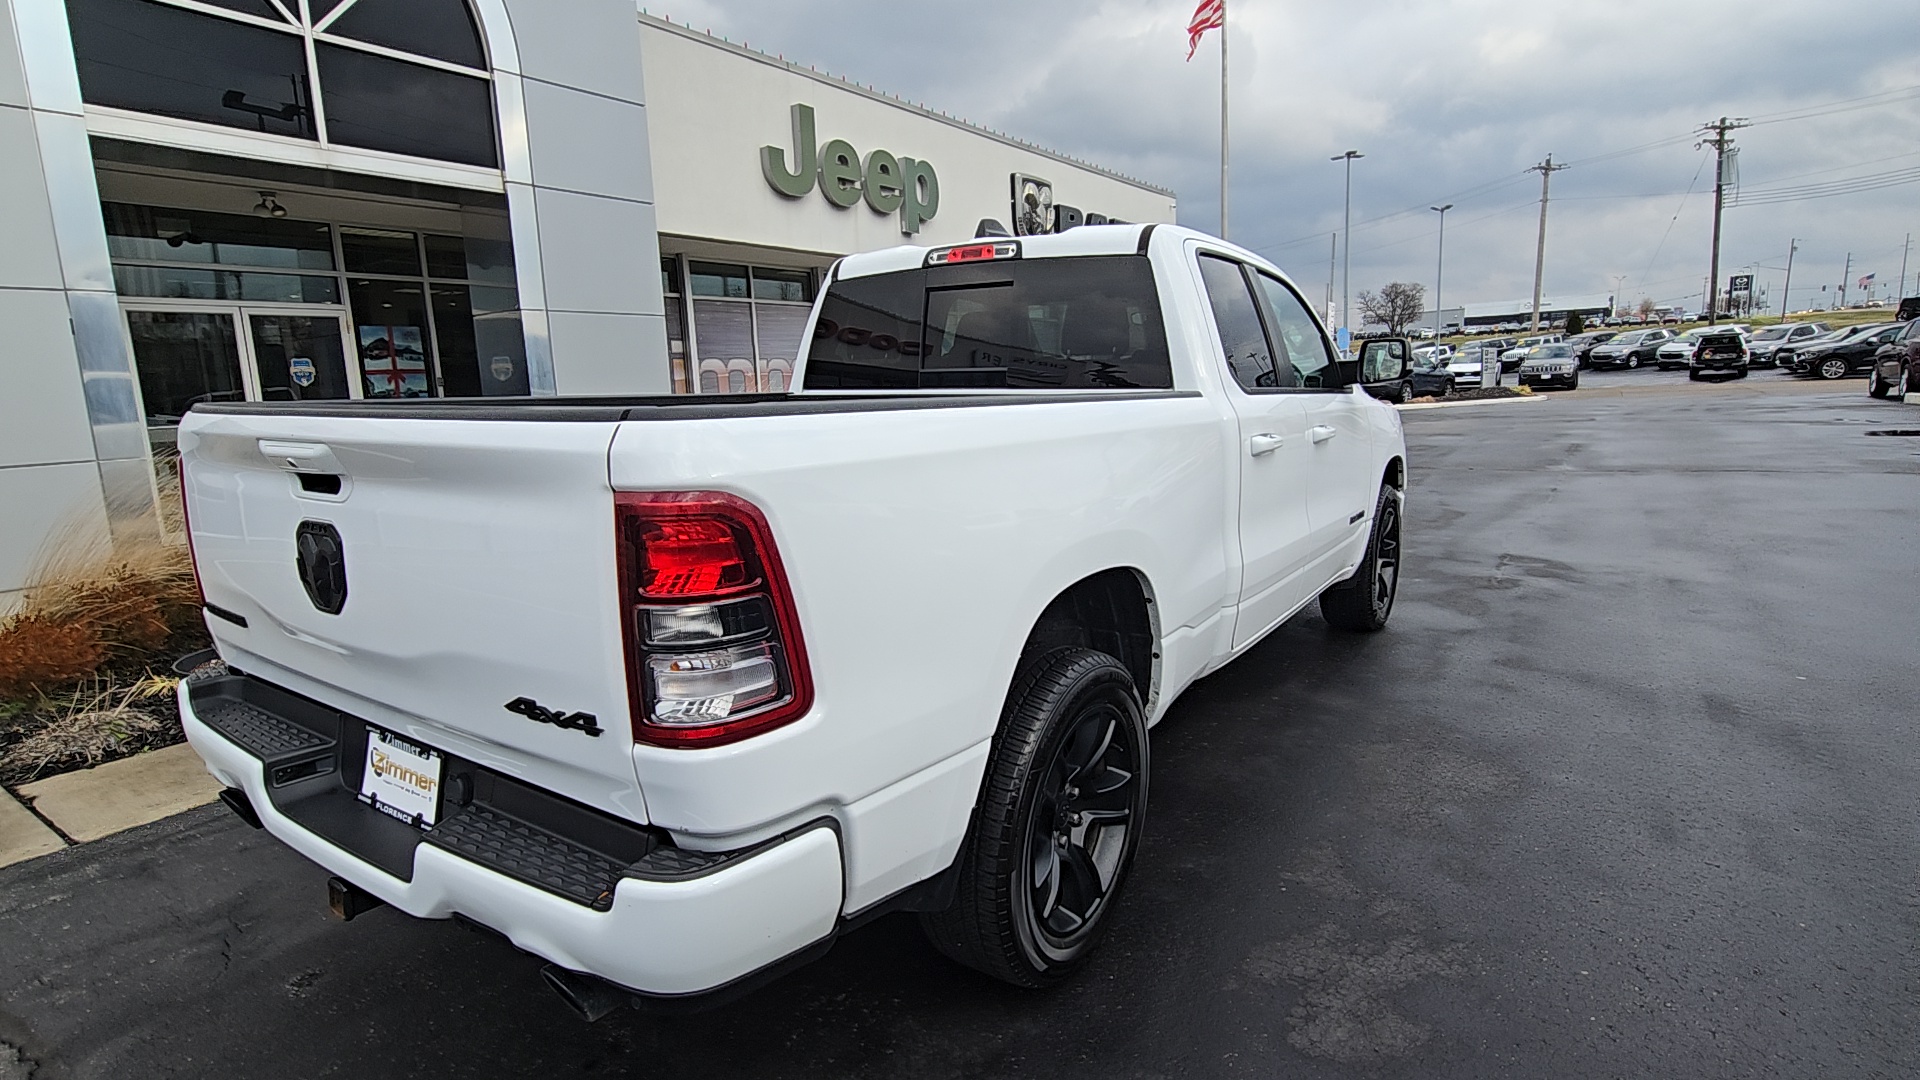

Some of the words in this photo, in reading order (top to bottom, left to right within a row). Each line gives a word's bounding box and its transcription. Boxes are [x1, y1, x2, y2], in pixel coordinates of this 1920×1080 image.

[760, 103, 940, 235] Jeep
[372, 750, 437, 792] Zimmer
[376, 802, 412, 824] FLORENCE
